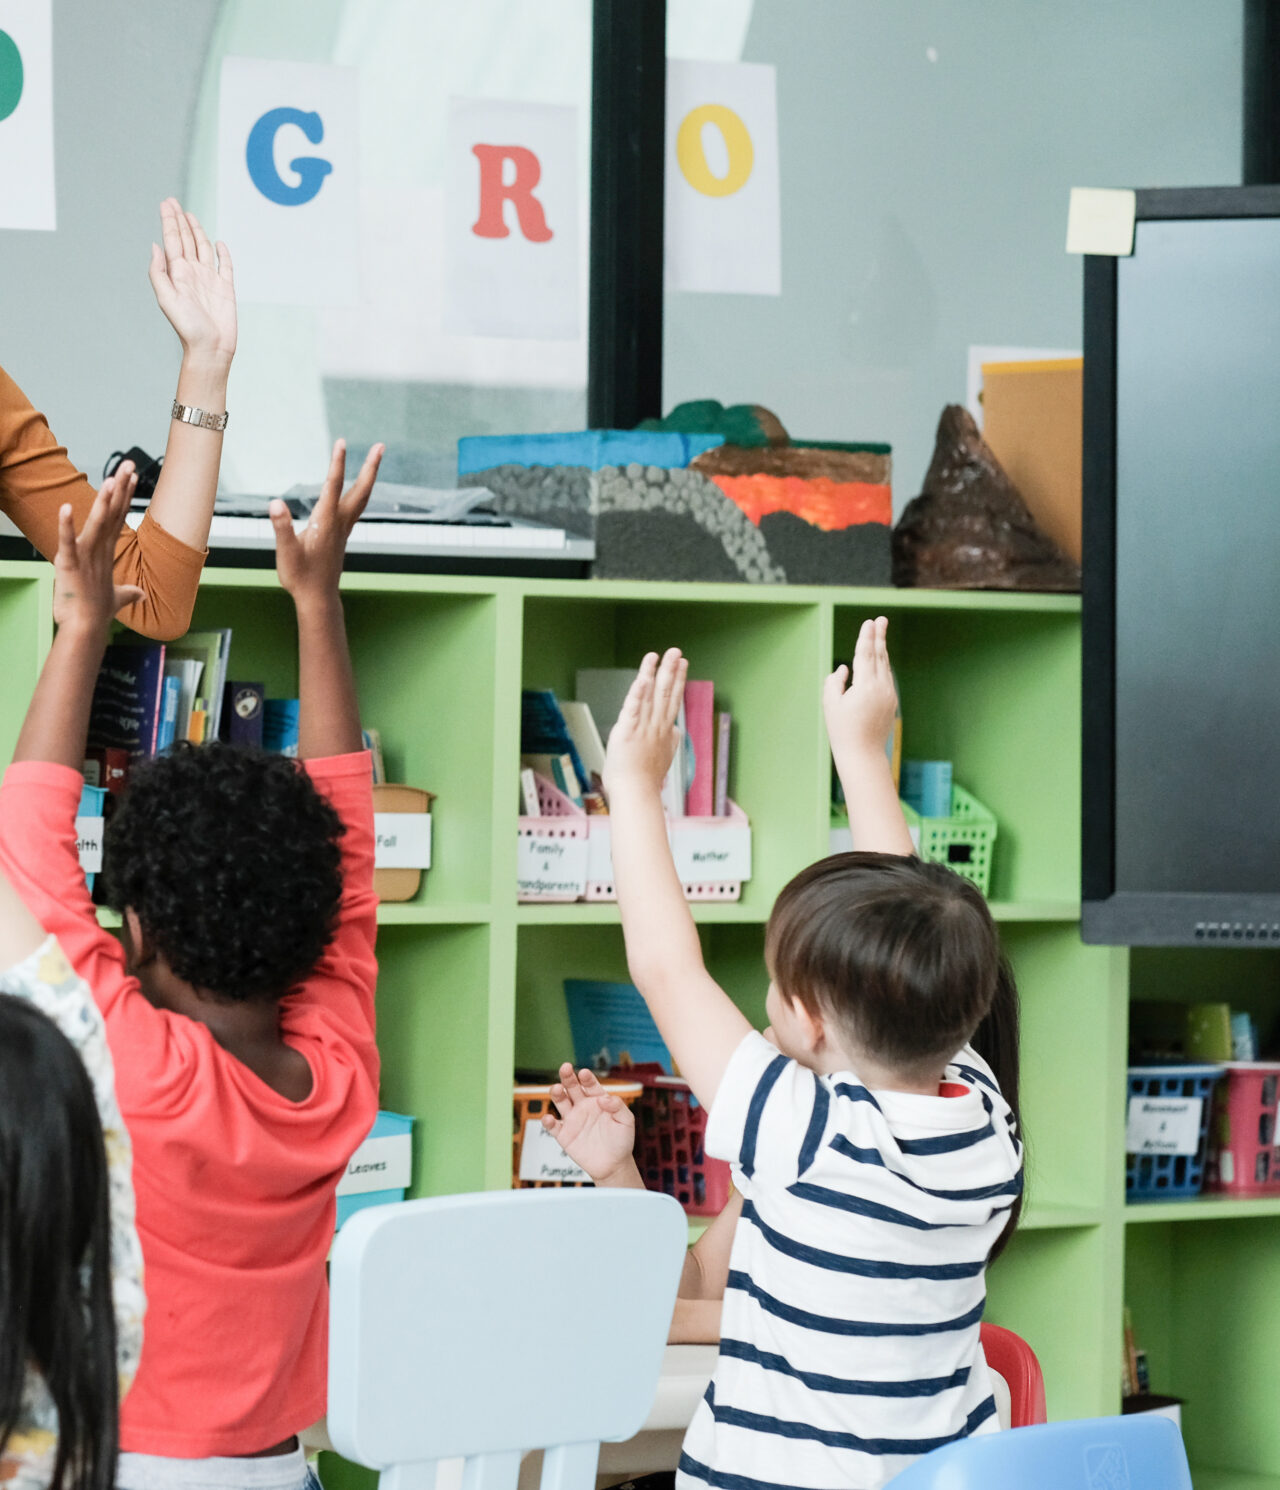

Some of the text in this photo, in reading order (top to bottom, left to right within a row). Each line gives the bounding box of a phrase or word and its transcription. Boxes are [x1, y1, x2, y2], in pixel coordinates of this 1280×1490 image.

[245, 106, 333, 208] G
[676, 103, 754, 198] O
[472, 143, 554, 243] R
[376, 835, 397, 848] Fall
[530, 841, 564, 857] Family
[518, 879, 580, 895] randparents
[348, 1161, 387, 1175] Leaves
[540, 1164, 583, 1179] Pumpkin
